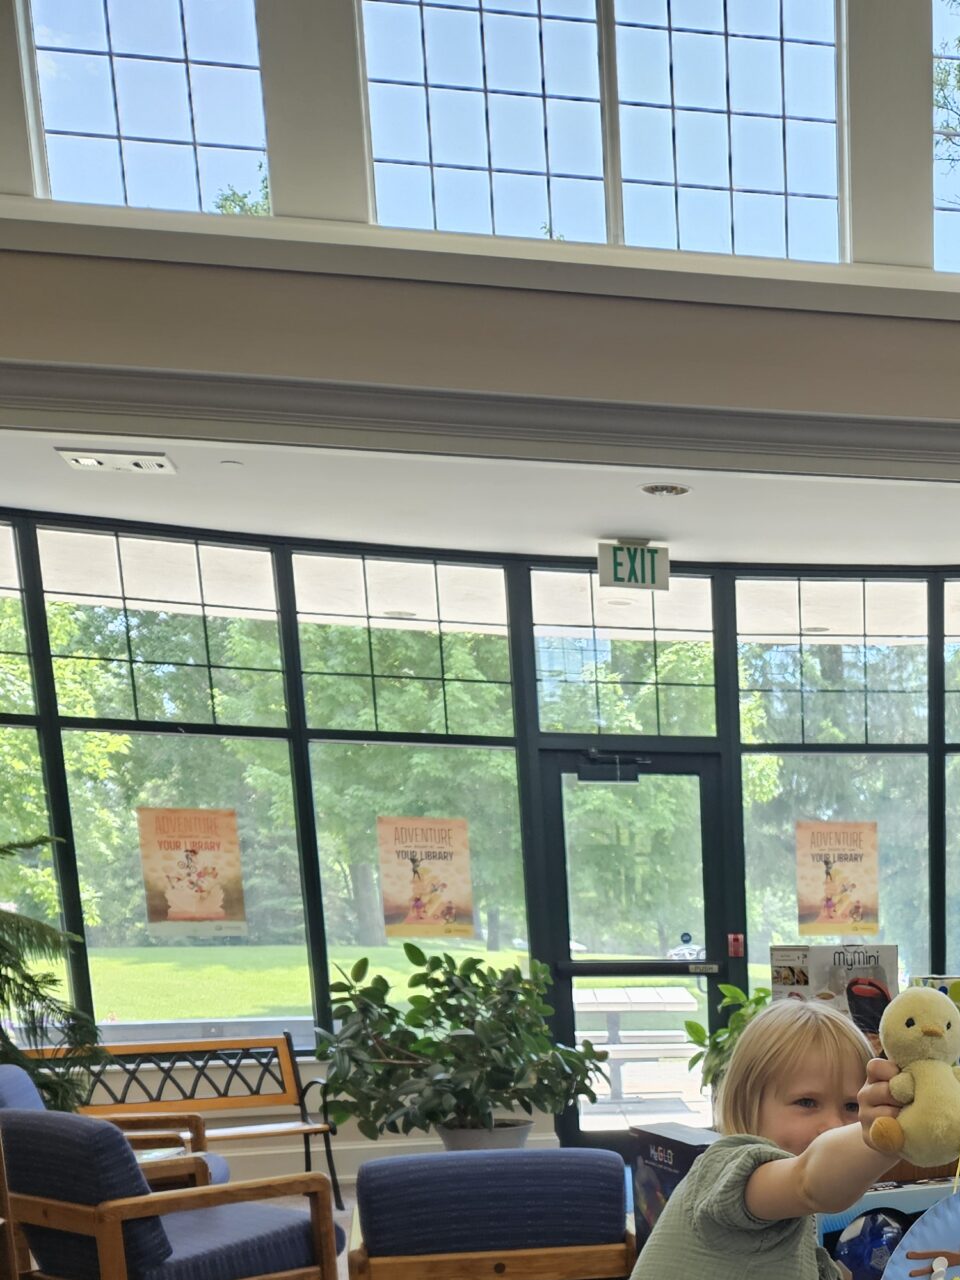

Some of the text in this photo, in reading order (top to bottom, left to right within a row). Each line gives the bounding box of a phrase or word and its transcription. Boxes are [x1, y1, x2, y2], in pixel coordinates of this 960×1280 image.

[612, 546, 658, 584] EXIT
[394, 826, 455, 848] ADVENTURE
[810, 831, 864, 850] ADVENTURE
[395, 850, 454, 861] YOUR LIBRARY
[811, 853, 864, 863] YOUR LIBRARY
